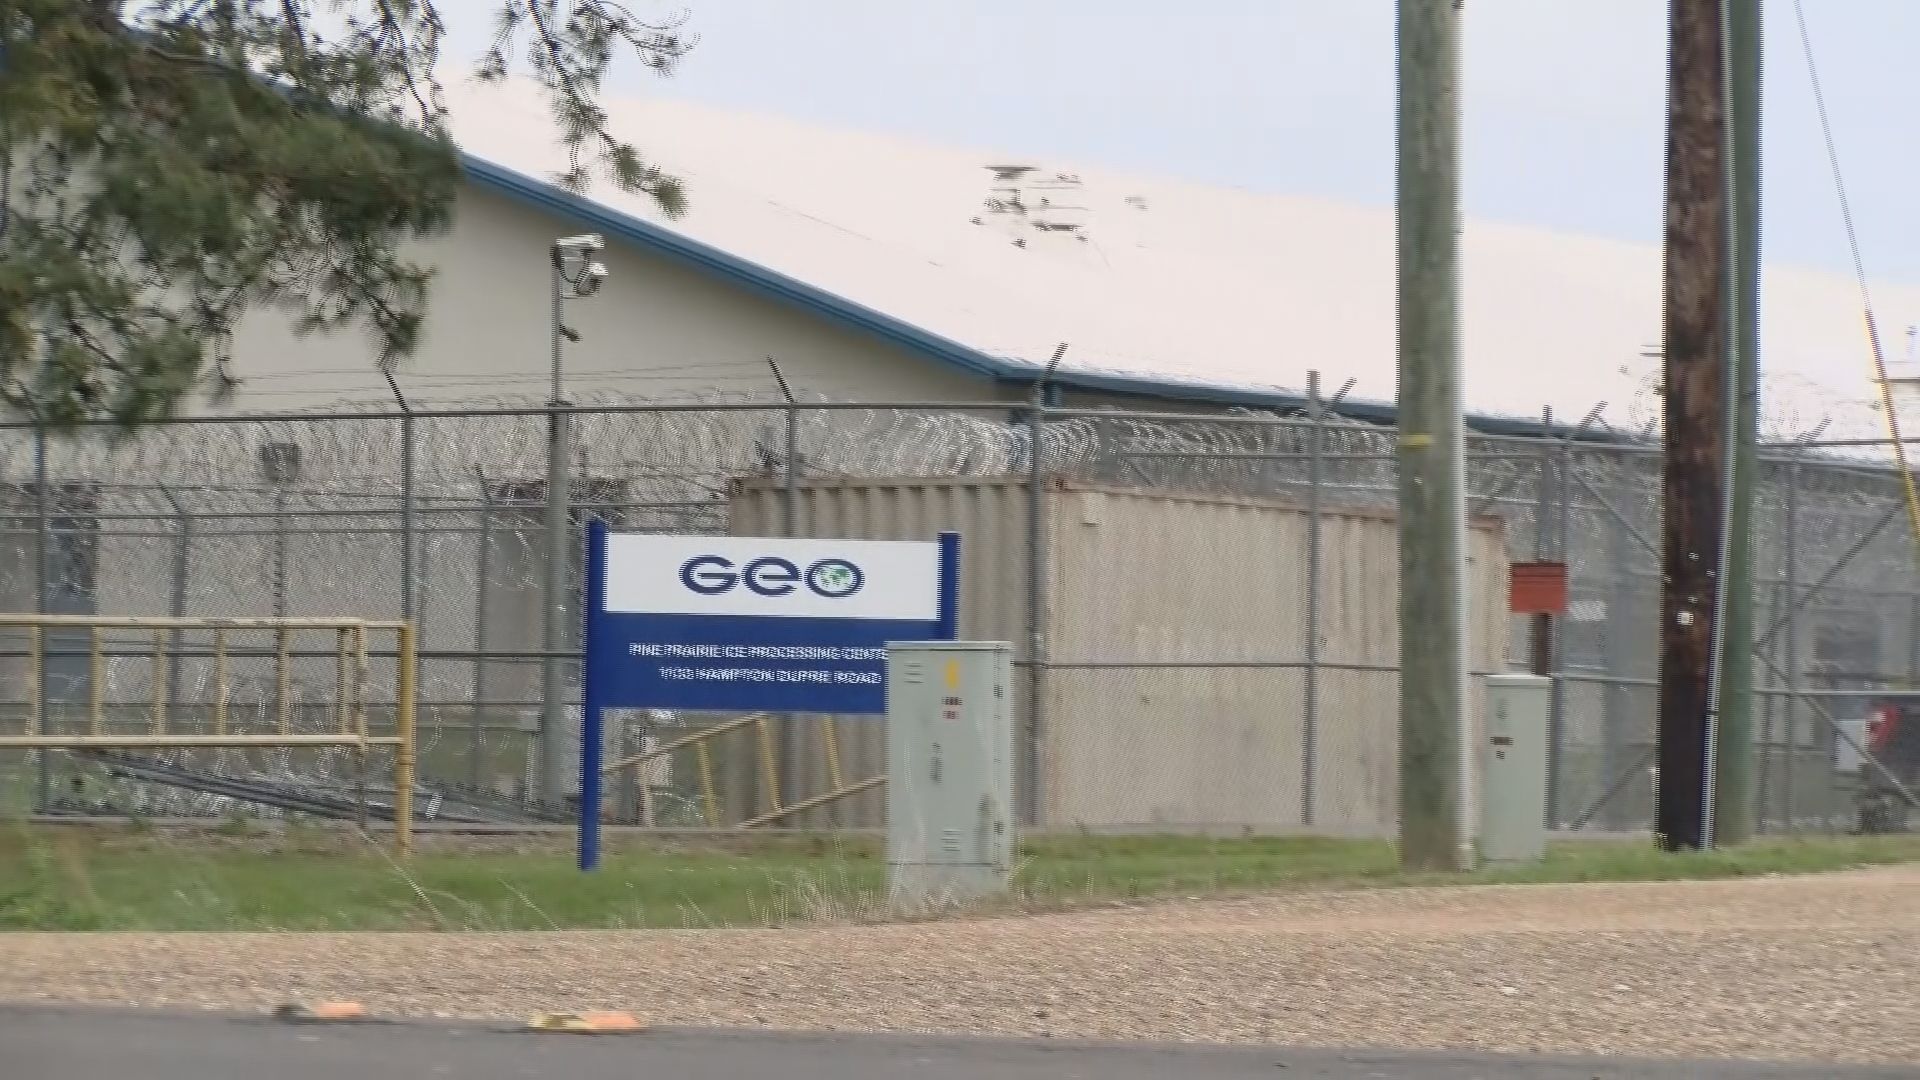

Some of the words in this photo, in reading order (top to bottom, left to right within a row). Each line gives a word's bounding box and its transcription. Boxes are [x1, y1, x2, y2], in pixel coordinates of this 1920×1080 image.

[629, 644, 664, 656] PINE
[664, 645, 721, 658] PRAIRIE
[722, 646, 748, 658] ICE
[748, 646, 841, 660] PROCESSING
[841, 648, 889, 660] CENTE
[658, 667, 695, 680] 1133
[695, 668, 775, 682] HAMPTON
[776, 670, 832, 684] DUPRE
[833, 671, 882, 684] ROAD
